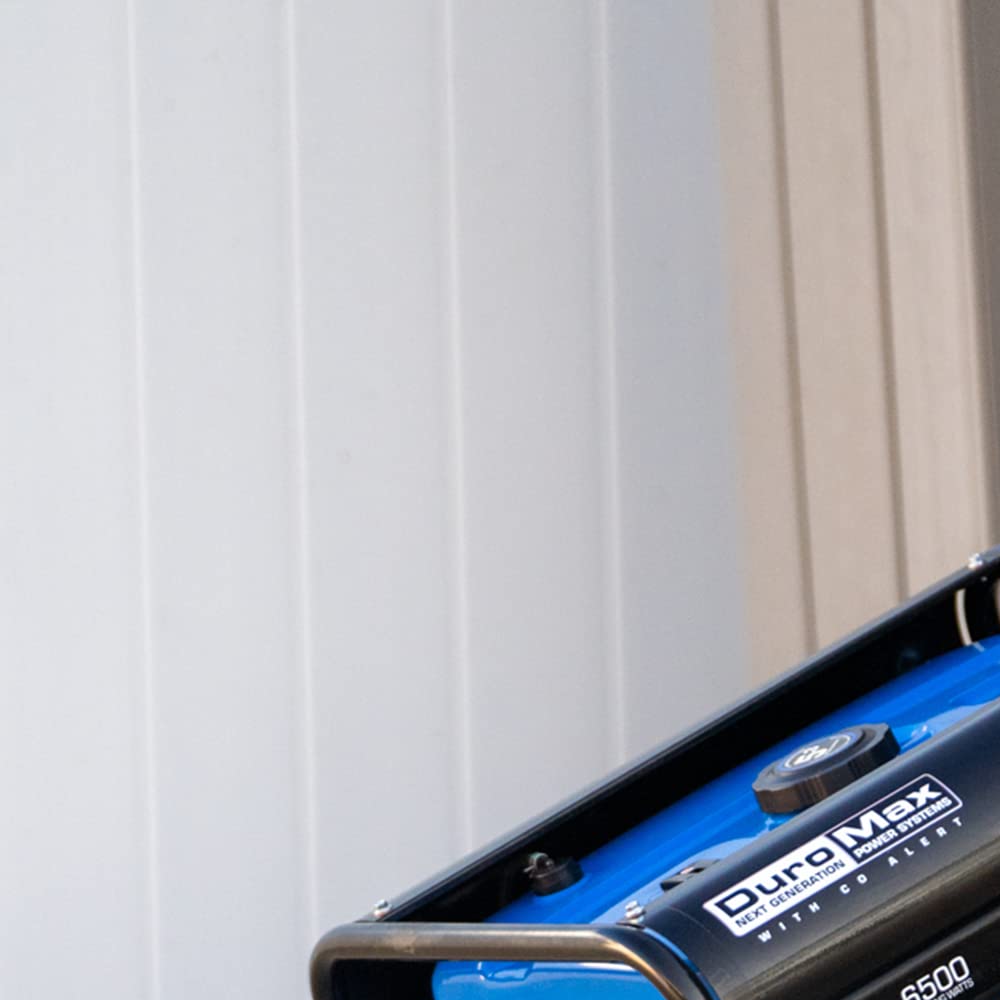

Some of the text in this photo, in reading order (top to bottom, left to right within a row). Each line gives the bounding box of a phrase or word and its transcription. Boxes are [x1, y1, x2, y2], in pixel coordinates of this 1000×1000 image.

[713, 783, 943, 918] DuroMax
[853, 796, 952, 859] POWER SYSTEMS
[735, 859, 847, 928] NEXT GENERATION
[758, 816, 963, 943] WITH CO ALERT
[946, 977, 975, 1000] WATTS
